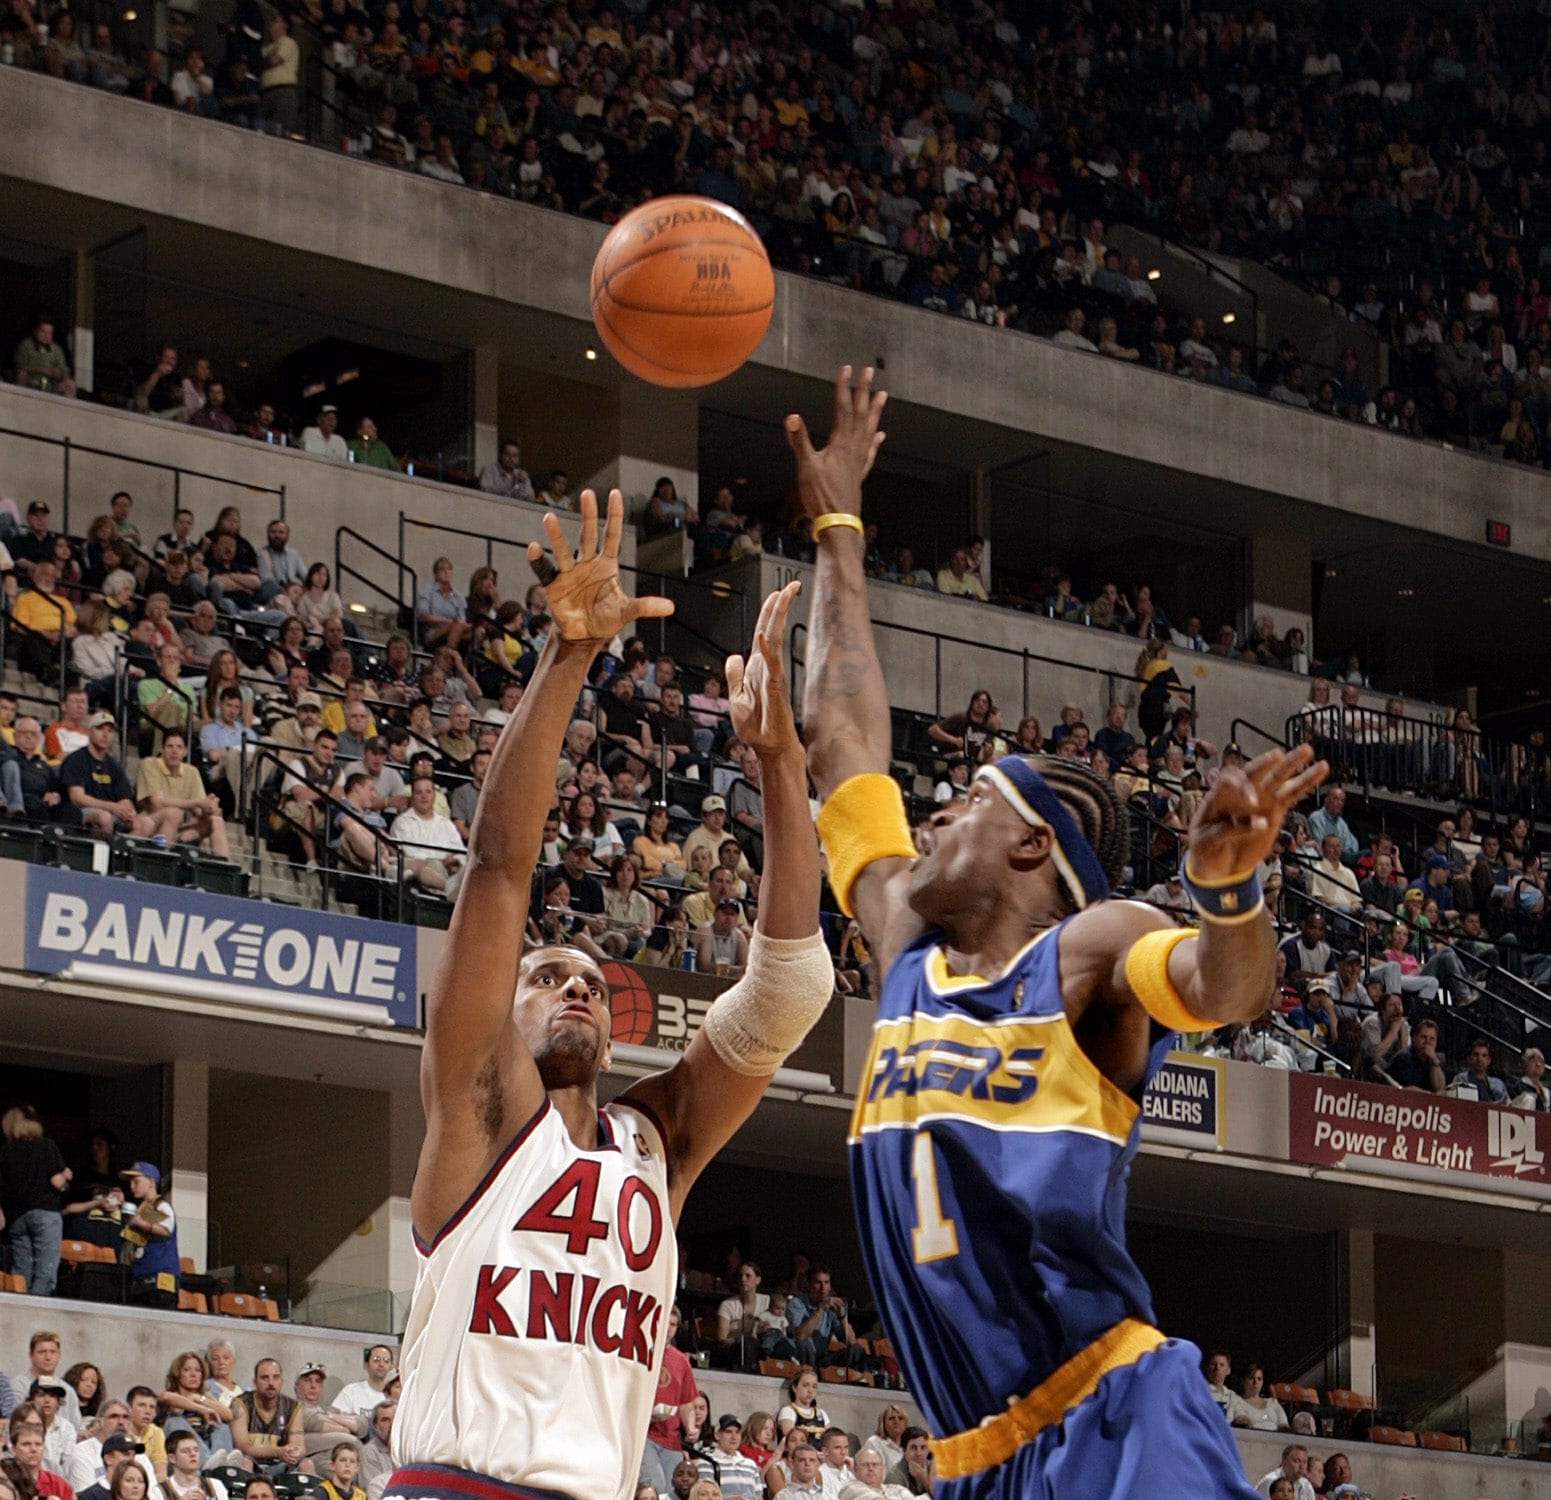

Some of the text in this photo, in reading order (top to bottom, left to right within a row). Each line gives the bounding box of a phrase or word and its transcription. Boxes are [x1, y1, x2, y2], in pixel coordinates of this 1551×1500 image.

[696, 263, 730, 280] NBA
[1146, 1070, 1209, 1099] NDIANA
[1142, 1094, 1202, 1124] EALERS
[1314, 1087, 1452, 1134] Indianapolis
[1314, 1121, 1474, 1171] Power & Light
[1486, 1109, 1545, 1164] IPL
[512, 1158, 663, 1272] 40
[911, 1130, 960, 1265] 1
